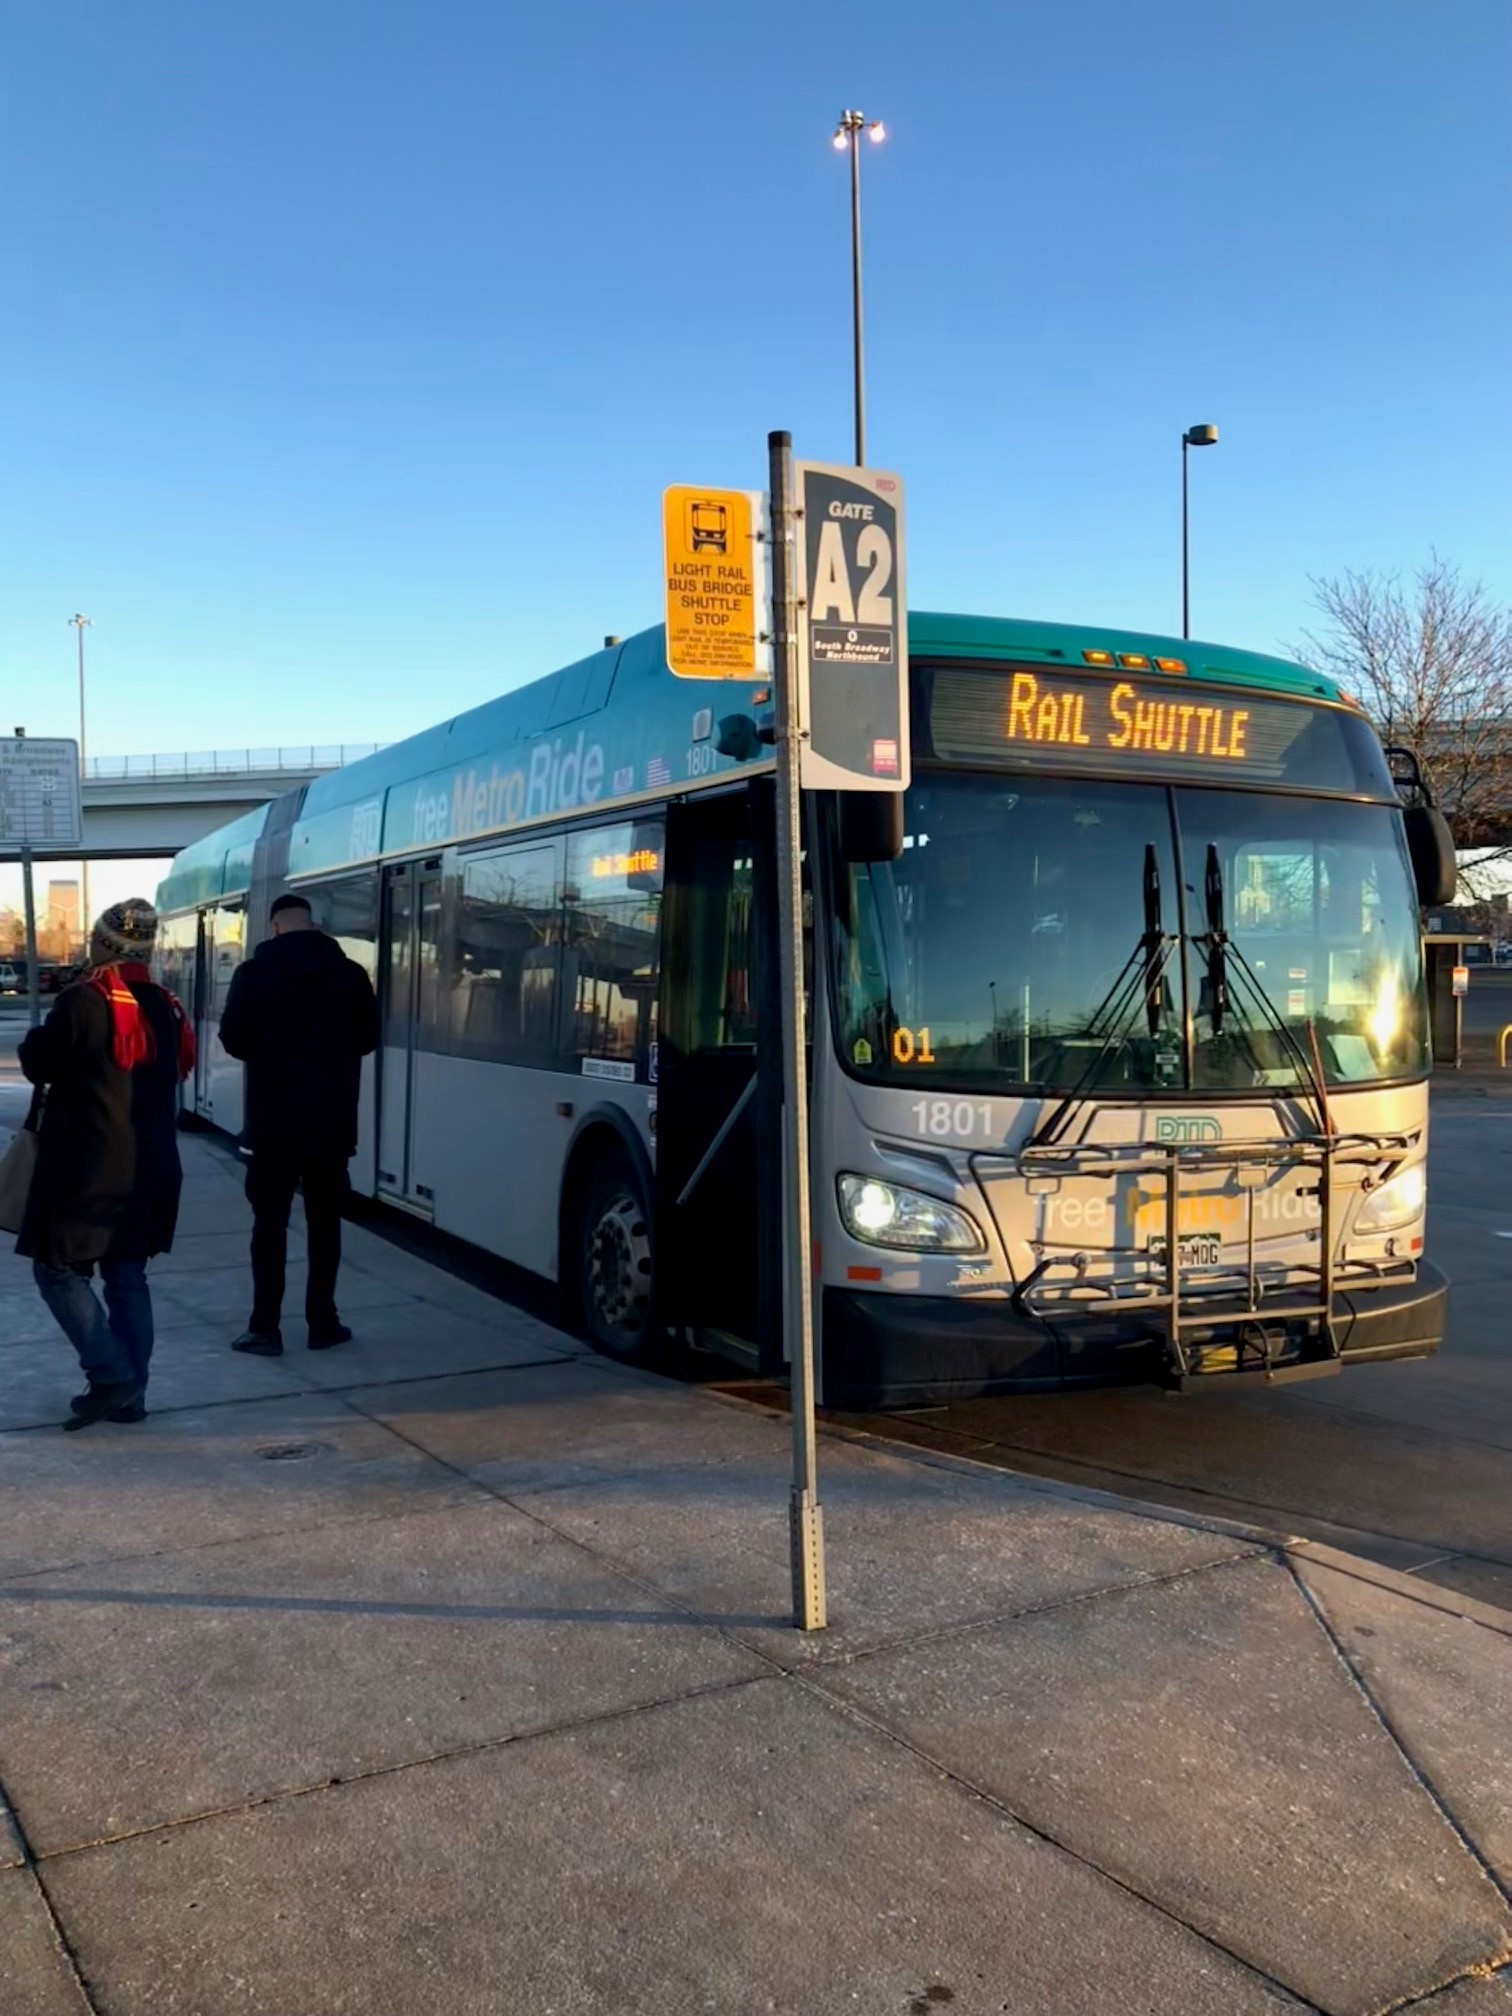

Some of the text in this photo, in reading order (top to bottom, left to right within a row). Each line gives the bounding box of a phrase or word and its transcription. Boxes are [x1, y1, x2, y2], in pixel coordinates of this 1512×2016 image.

[828, 501, 875, 520] GATE
[673, 563, 746, 580] LIGHT RAIL
[810, 520, 893, 626] A2
[668, 578, 753, 596] BUS BRIDGE
[681, 595, 742, 611] SHUTTLE
[694, 612, 730, 626] STOP
[814, 641, 891, 655] South Broadway
[826, 651, 880, 660] Northbound
[1007, 672, 1249, 757] RAIL SHUTTLE
[686, 746, 717, 776] 1801
[413, 787, 449, 843] free
[893, 1027, 935, 1063] 01
[912, 1100, 992, 1135] 1801
[1156, 1116, 1222, 1143] RTD
